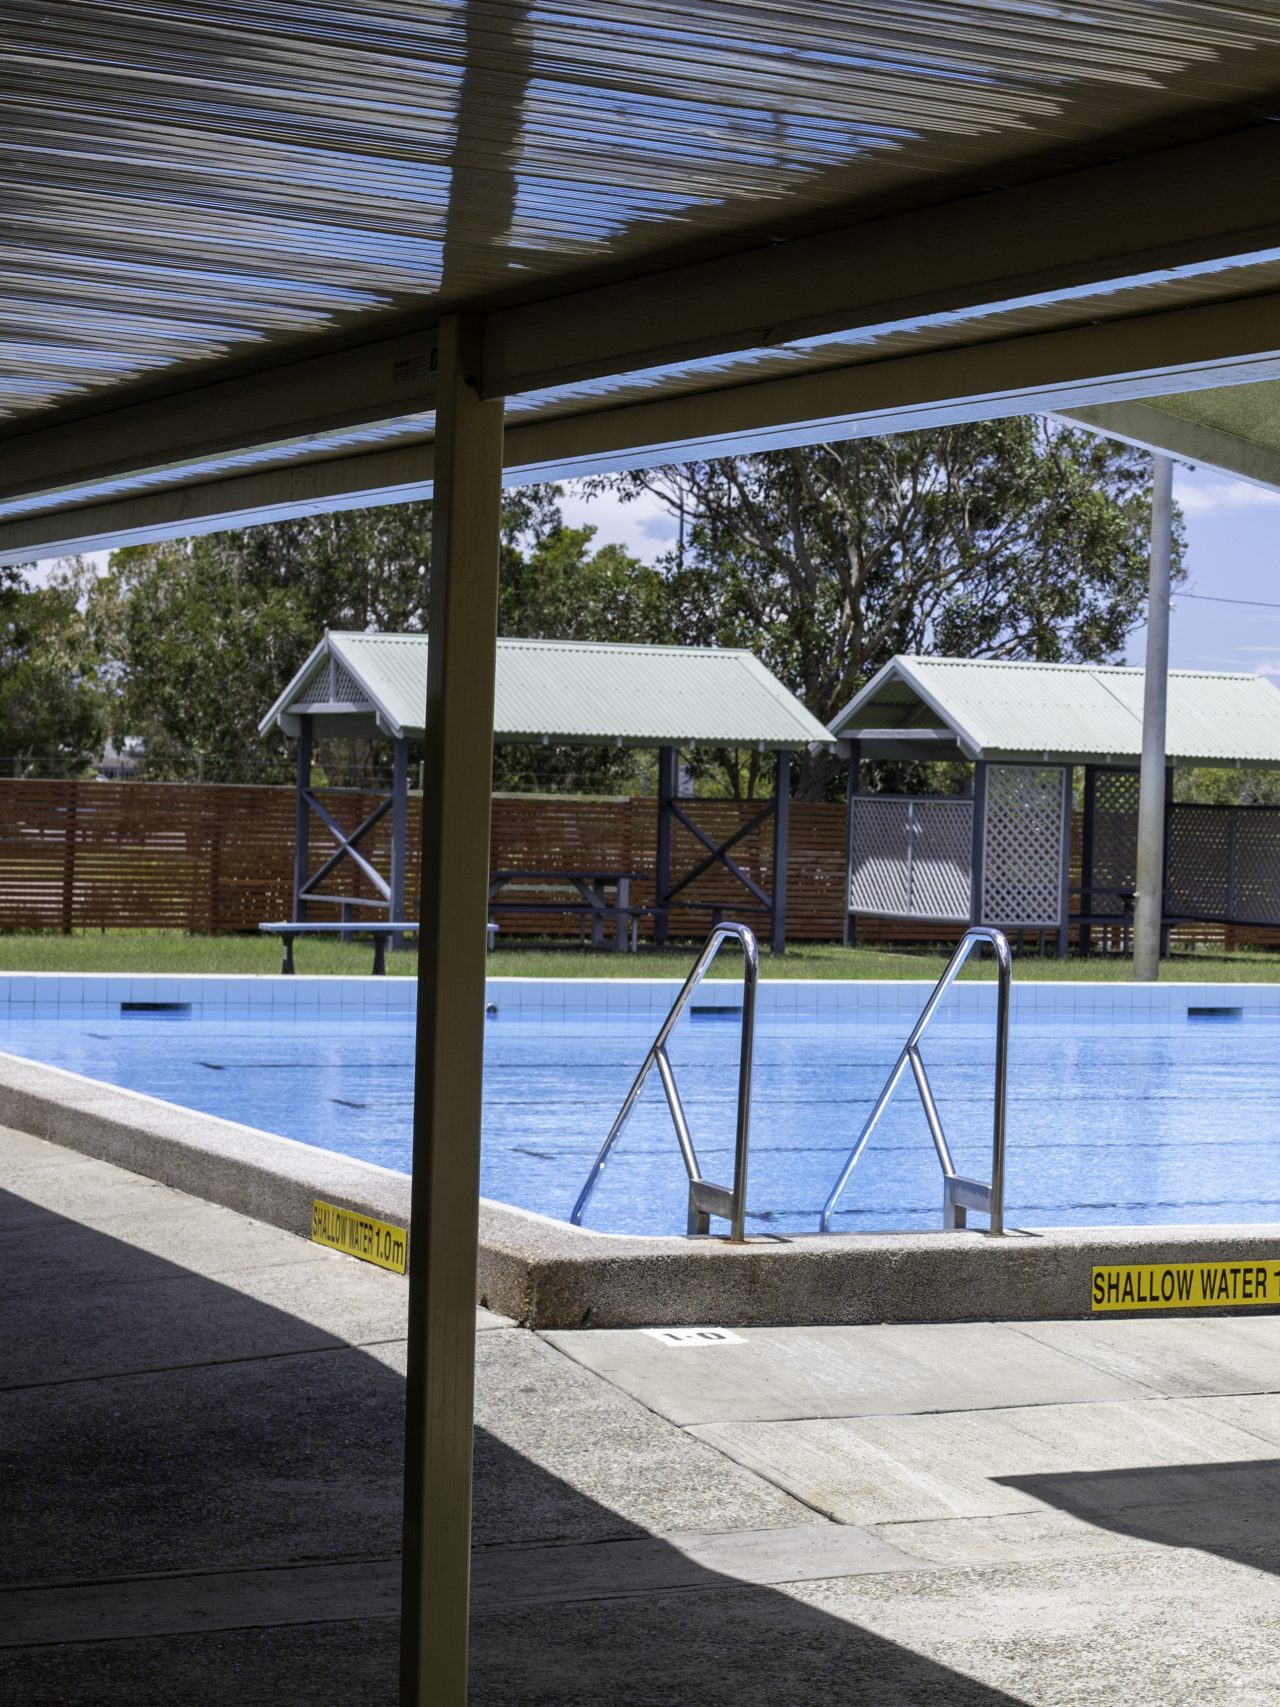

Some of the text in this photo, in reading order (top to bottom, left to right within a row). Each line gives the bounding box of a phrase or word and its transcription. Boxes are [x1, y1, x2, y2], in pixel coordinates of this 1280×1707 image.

[313, 1206, 404, 1266] SHALLOW WATER 1.0m
[1093, 1269, 1194, 1304] SHALLOW
[1200, 1267, 1267, 1300] WATER
